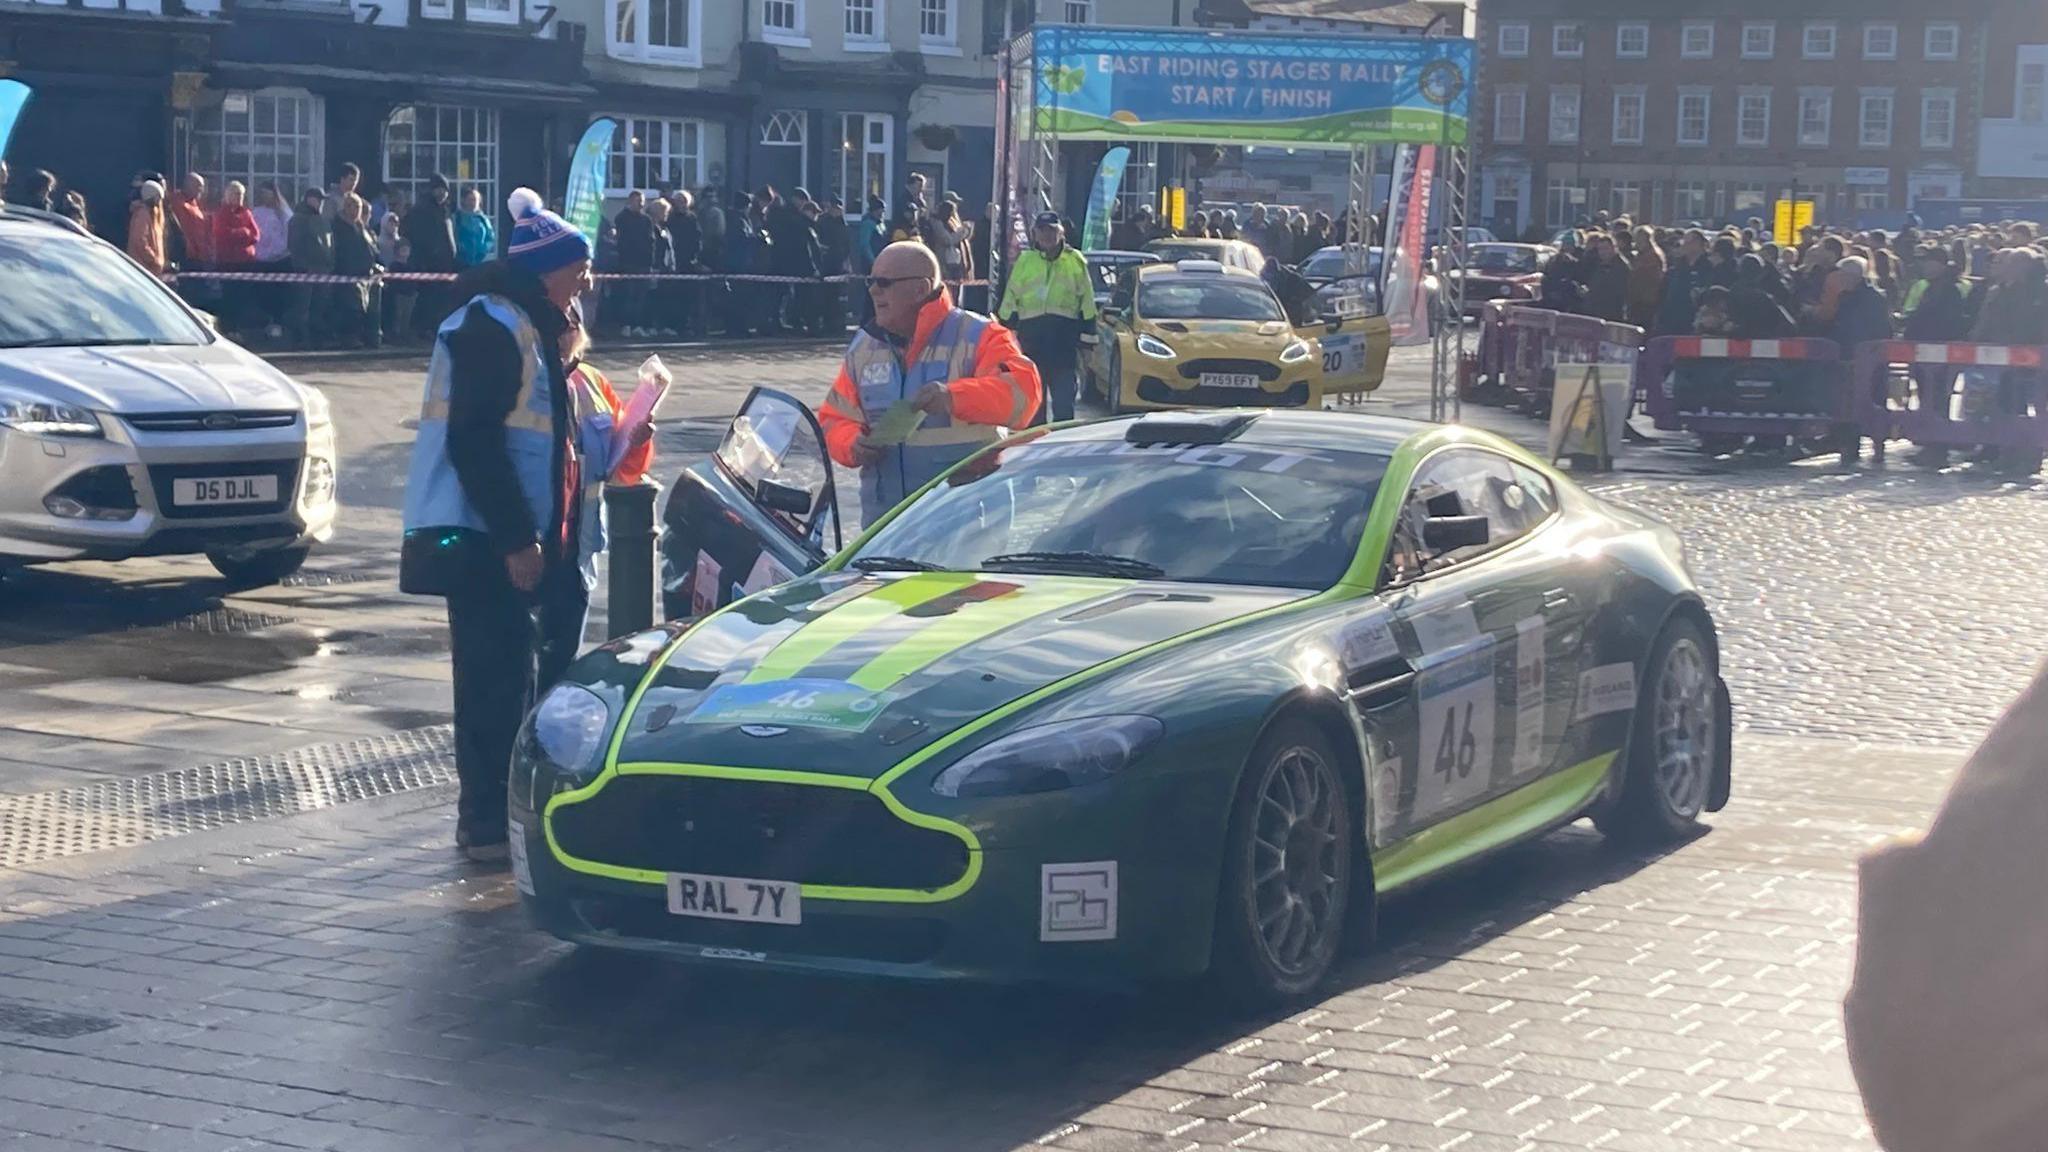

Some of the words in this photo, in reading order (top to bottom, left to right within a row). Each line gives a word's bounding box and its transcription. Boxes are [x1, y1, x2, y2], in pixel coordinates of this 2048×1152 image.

[1098, 54, 1151, 75] EAST
[1158, 57, 1239, 79] RIDING
[1247, 60, 1332, 82] STAGES
[1339, 62, 1407, 83] RALLY
[1171, 85, 1236, 106] START
[1243, 88, 1254, 108] /
[1261, 88, 1332, 108] FINISH
[1233, 374, 1254, 387] EFY
[195, 480, 220, 500] D5
[225, 479, 260, 499] DJL
[768, 689, 823, 709] 46
[1433, 700, 1476, 785] 46
[680, 878, 738, 915] RAL
[747, 884, 786, 918] 7Y
